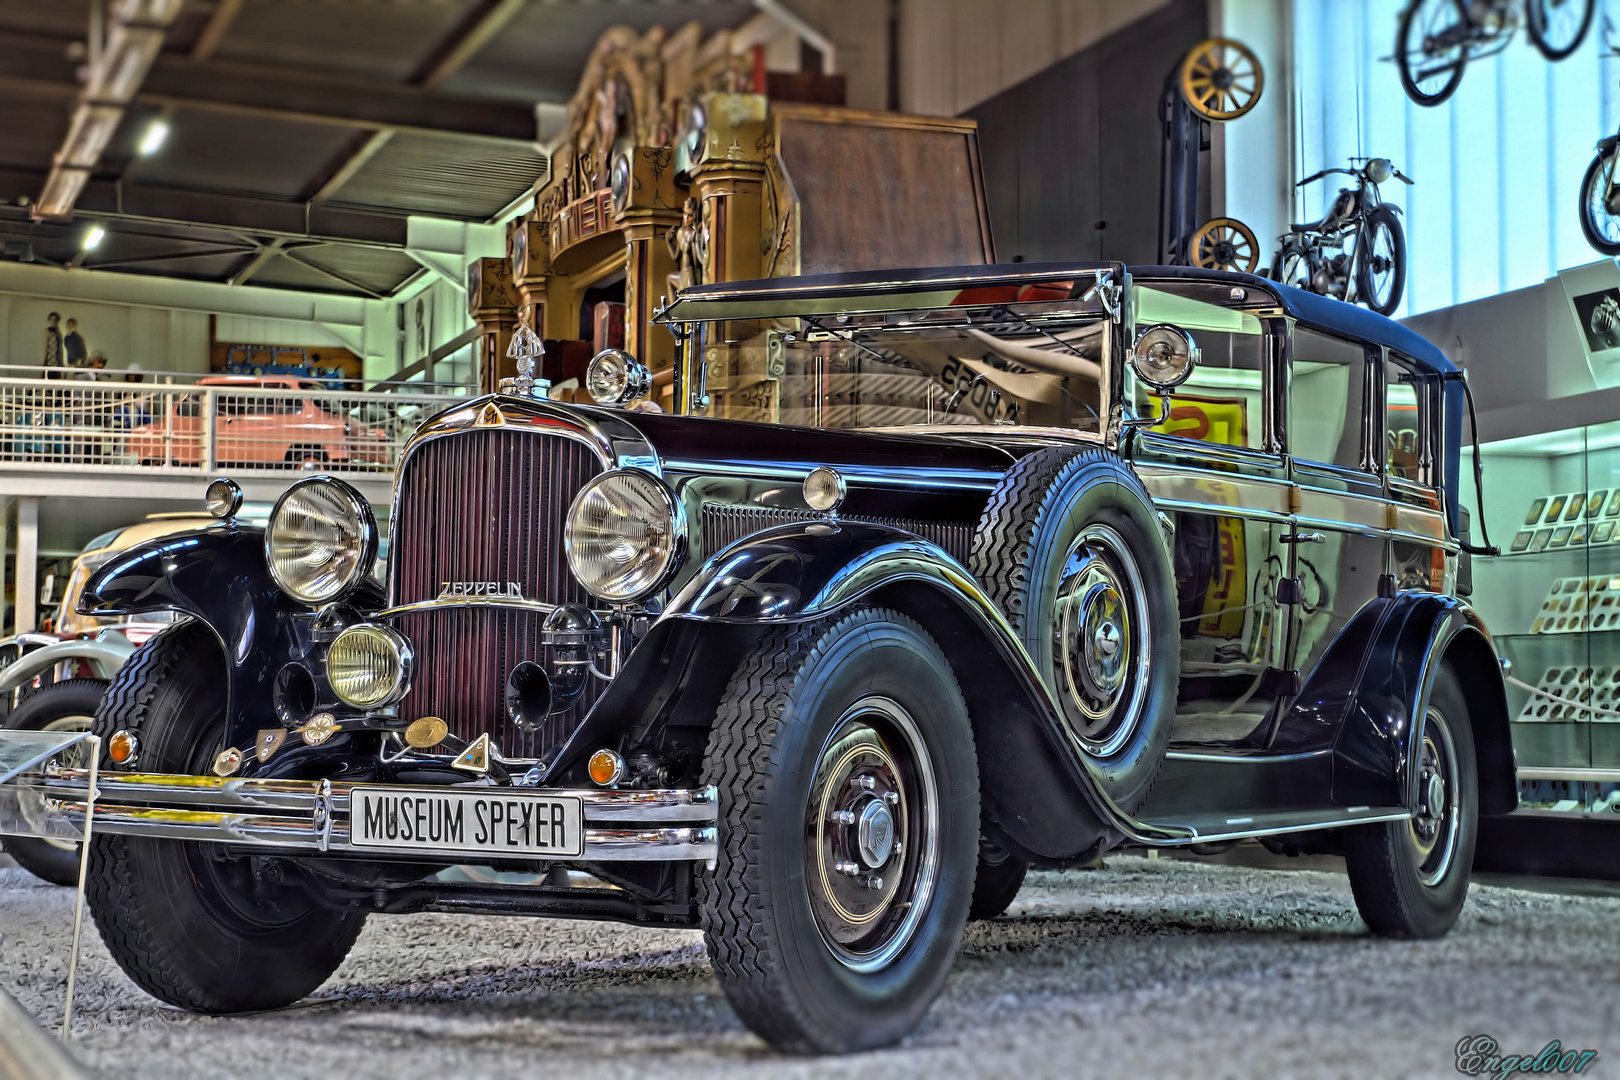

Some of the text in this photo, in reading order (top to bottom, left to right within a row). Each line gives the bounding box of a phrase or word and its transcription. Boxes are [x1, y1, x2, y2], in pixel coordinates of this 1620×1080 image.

[440, 582, 521, 596] ZEPPELIN
[364, 796, 566, 847] MUSEUM SPEYER
